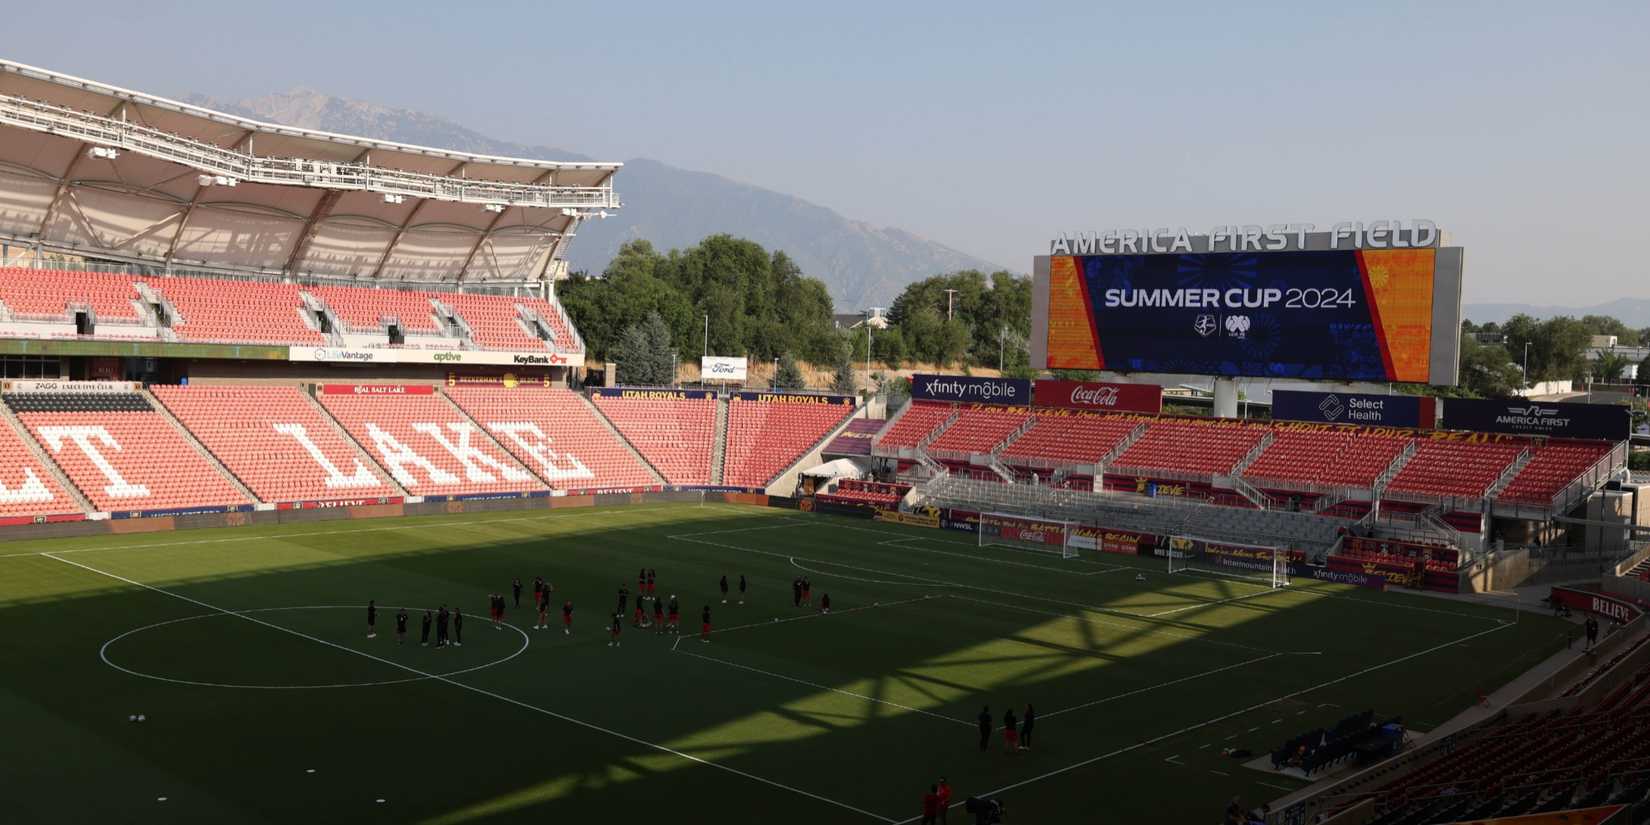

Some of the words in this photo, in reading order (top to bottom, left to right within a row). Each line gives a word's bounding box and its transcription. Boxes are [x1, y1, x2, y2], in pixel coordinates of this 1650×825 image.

[1051, 226, 1193, 254] AMERICA
[1208, 223, 1315, 251] FIRST
[1330, 219, 1437, 248] FIELD
[1105, 288, 1219, 308] SUMMER
[1224, 288, 1282, 308] CUP
[1285, 288, 1356, 309] 2024
[434, 352, 461, 361] aptive
[514, 355, 549, 365] KeyBank
[712, 363, 735, 374] Ford
[354, 386, 369, 394] REAL
[926, 380, 966, 396] xfinity
[969, 382, 1016, 399] mobile
[622, 390, 648, 400] UTAH
[649, 391, 686, 401] ROYALS
[758, 394, 788, 404] UTAH
[790, 396, 828, 405] ROYALS
[1071, 386, 1119, 406] Coca-Cola
[1349, 398, 1384, 410] Select
[1348, 409, 1382, 420] Health
[1495, 415, 1539, 426] AMERICA
[1541, 417, 1571, 427] FIRST
[1313, 569, 1338, 580] xfinity
[1592, 596, 1630, 622] BELIEVE
